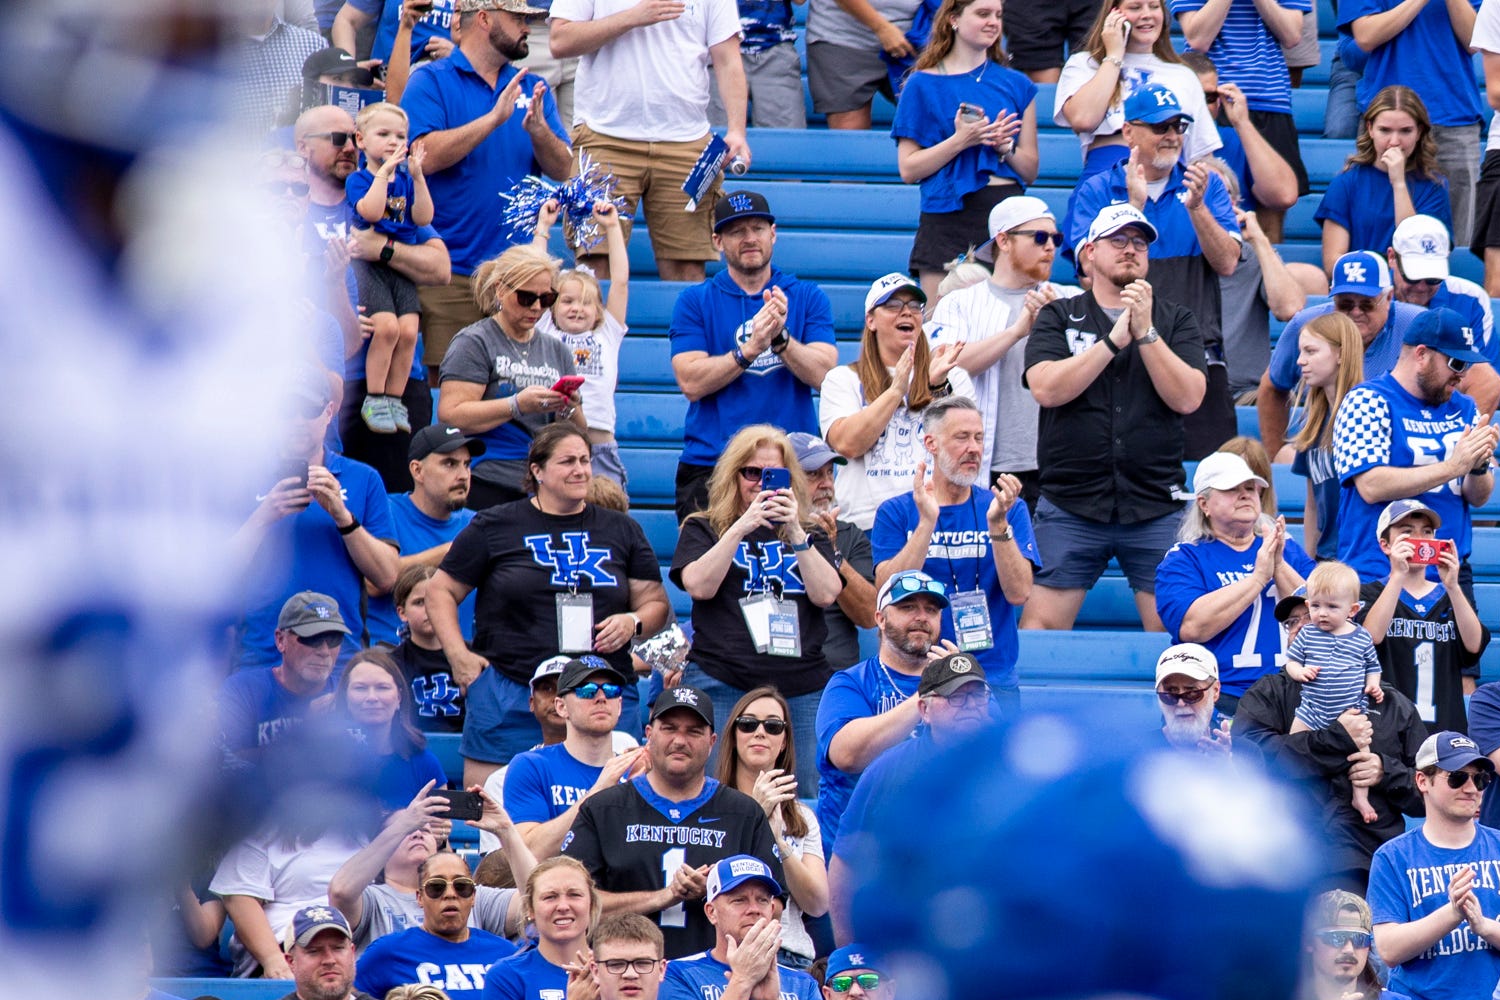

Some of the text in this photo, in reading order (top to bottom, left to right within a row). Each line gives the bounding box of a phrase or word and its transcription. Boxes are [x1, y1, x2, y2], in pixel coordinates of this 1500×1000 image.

[1154, 91, 1176, 106] K
[1343, 262, 1367, 282] UK
[1402, 416, 1464, 435] KENTUCKY
[866, 468, 878, 477] FOR
[880, 468, 892, 477] THE
[893, 469, 910, 478] BLUE
[907, 530, 992, 546] NTUCKY
[524, 532, 617, 586] UK
[733, 541, 804, 593] UK
[1387, 618, 1456, 642] KENTUCKY
[1415, 642, 1437, 722] 1
[412, 673, 460, 717] UK
[673, 688, 699, 706] UK
[625, 823, 726, 849] KENTUCKY
[661, 847, 687, 928] 1
[416, 961, 491, 991] CAT
